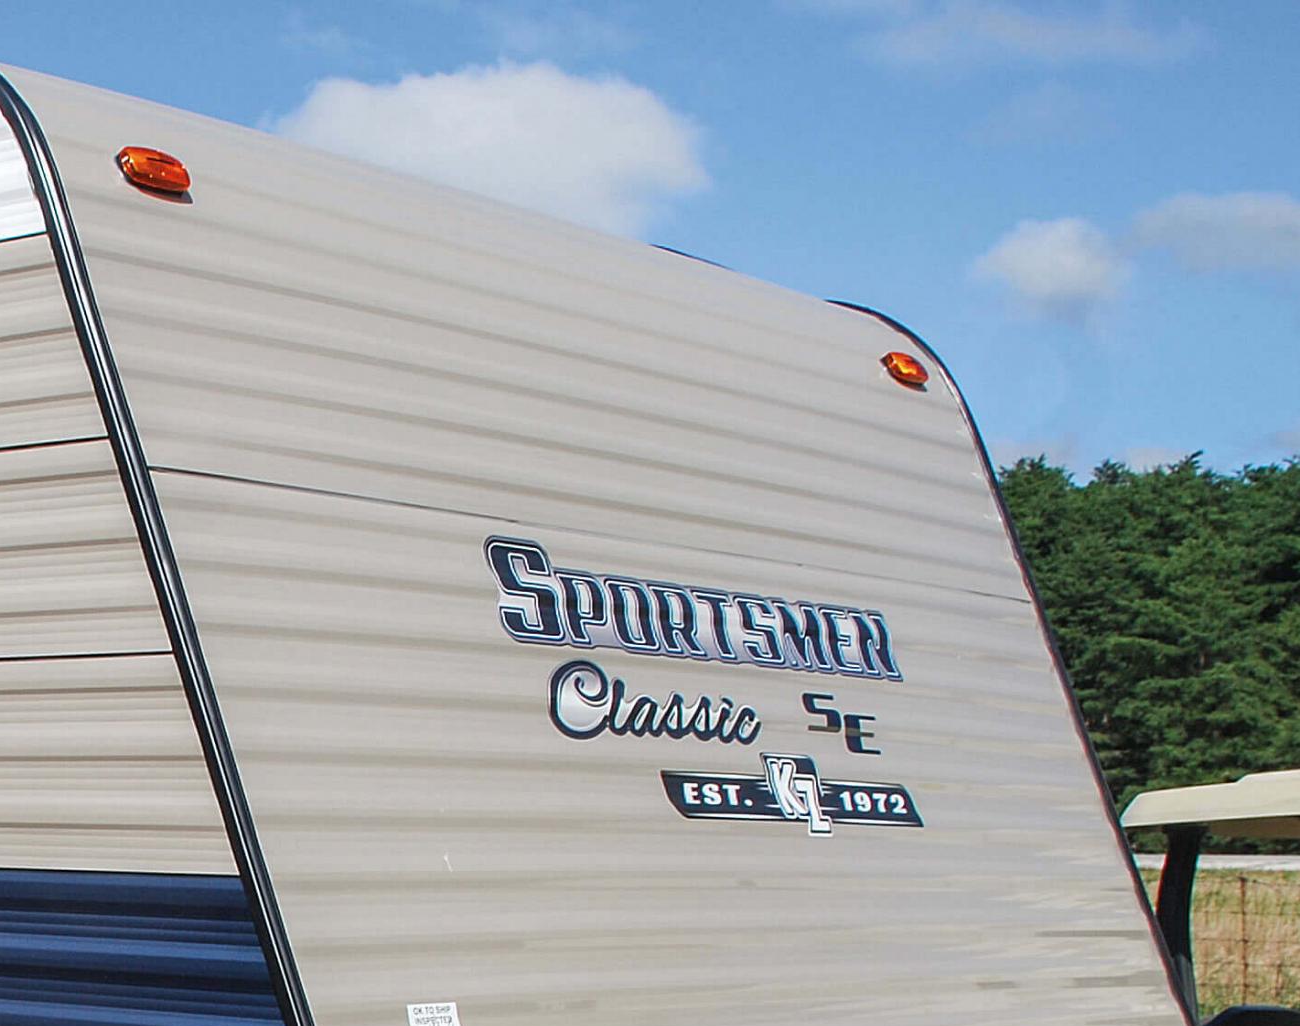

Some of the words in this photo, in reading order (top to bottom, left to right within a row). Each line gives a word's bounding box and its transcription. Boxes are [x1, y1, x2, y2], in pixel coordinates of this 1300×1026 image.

[548, 659, 762, 746] Classic
[802, 692, 882, 755] SE
[683, 781, 754, 808] EST.
[838, 790, 908, 815] 1972
[425, 1006, 435, 1015] TO
